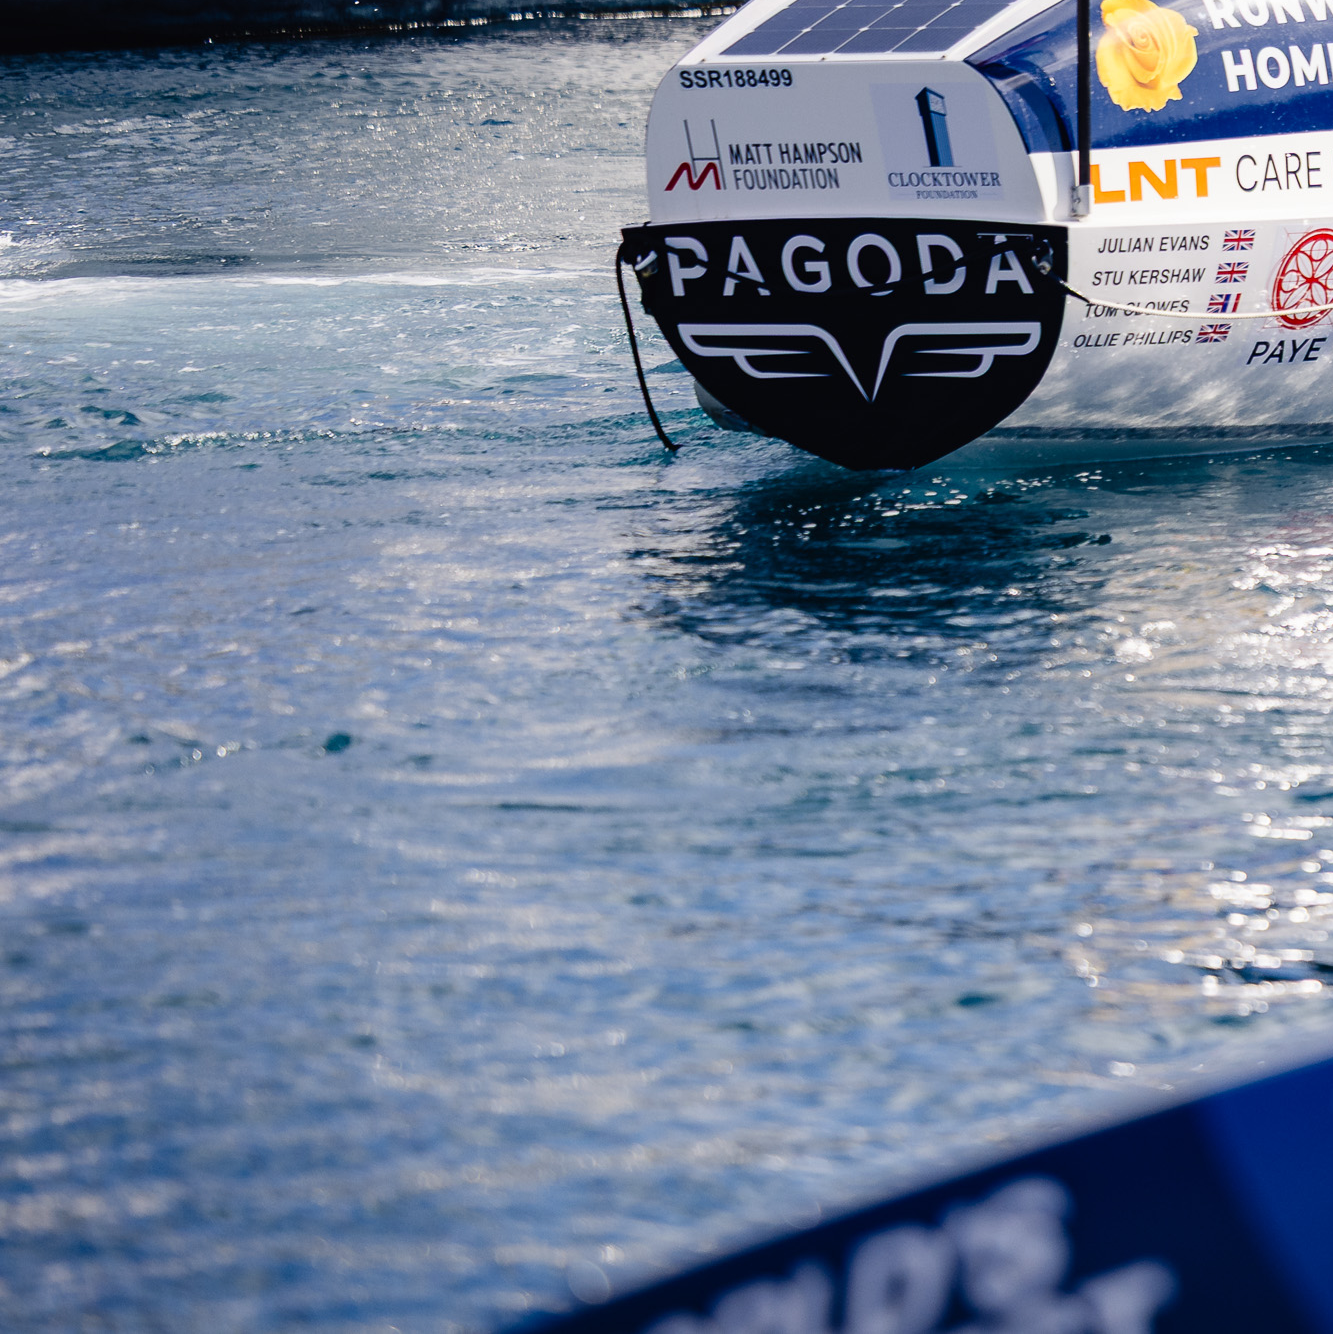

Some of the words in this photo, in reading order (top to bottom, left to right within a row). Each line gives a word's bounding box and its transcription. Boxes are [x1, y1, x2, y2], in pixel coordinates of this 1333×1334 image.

[679, 68, 793, 89] SSR188499
[729, 143, 773, 165] MATT
[777, 142, 863, 164] HAMPSON
[733, 168, 840, 191] FOUNDATION
[887, 172, 1002, 188] CLOCKTOWER
[1090, 157, 1221, 203] LNT
[1236, 151, 1325, 192] CARE
[916, 190, 979, 200] FOUNDATION
[1097, 237, 1155, 254] JULIAN
[1158, 235, 1210, 252] EVANS
[664, 233, 1034, 297] PAGODA
[1091, 270, 1124, 286] STU
[1127, 268, 1206, 285] KERSHAW
[1085, 302, 1119, 318] TOM
[1073, 332, 1120, 348] OLLIE
[1122, 329, 1193, 346] PHILLIPS
[1246, 337, 1328, 365] PAYE
